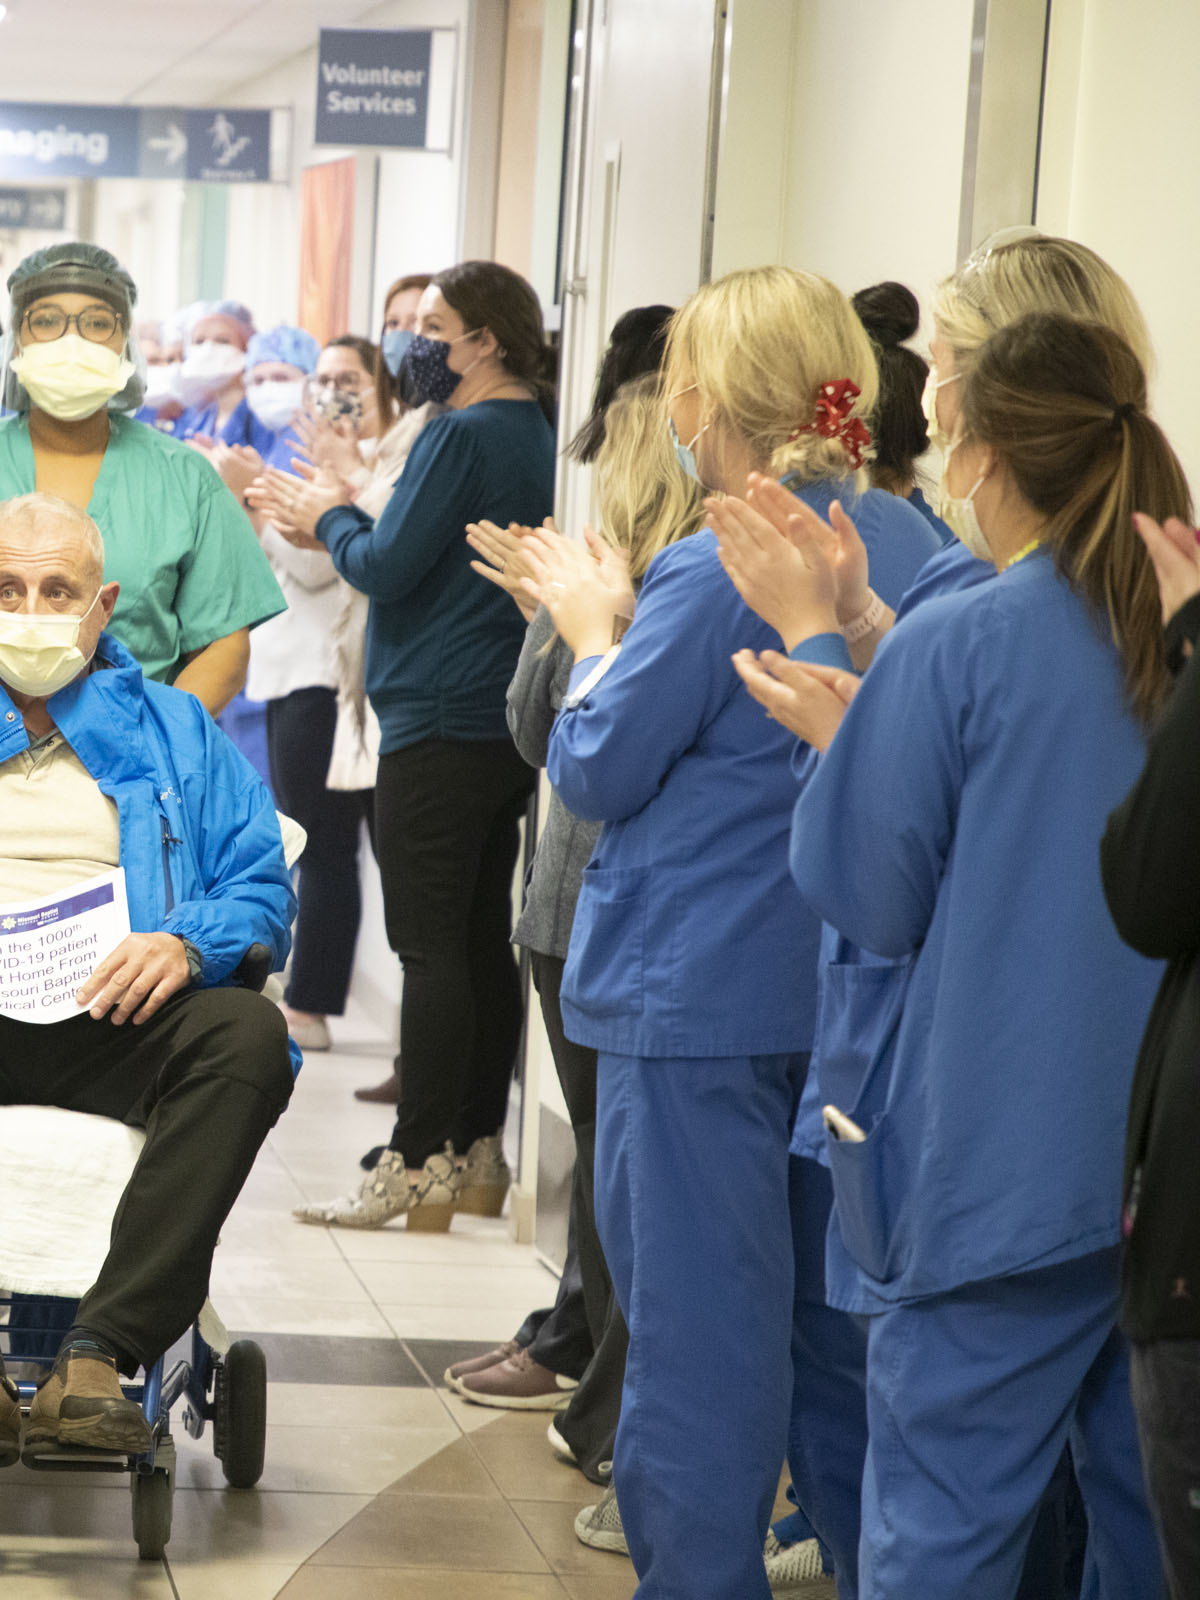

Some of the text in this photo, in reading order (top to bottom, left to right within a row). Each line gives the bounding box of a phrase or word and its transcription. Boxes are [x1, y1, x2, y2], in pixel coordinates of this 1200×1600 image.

[321, 62, 425, 86] Volunteer
[327, 90, 416, 114] Services
[8, 942, 32, 953] the
[49, 933, 98, 960] patient
[9, 965, 54, 983] Home
[59, 950, 97, 970] From
[44, 965, 93, 991] Baptist
